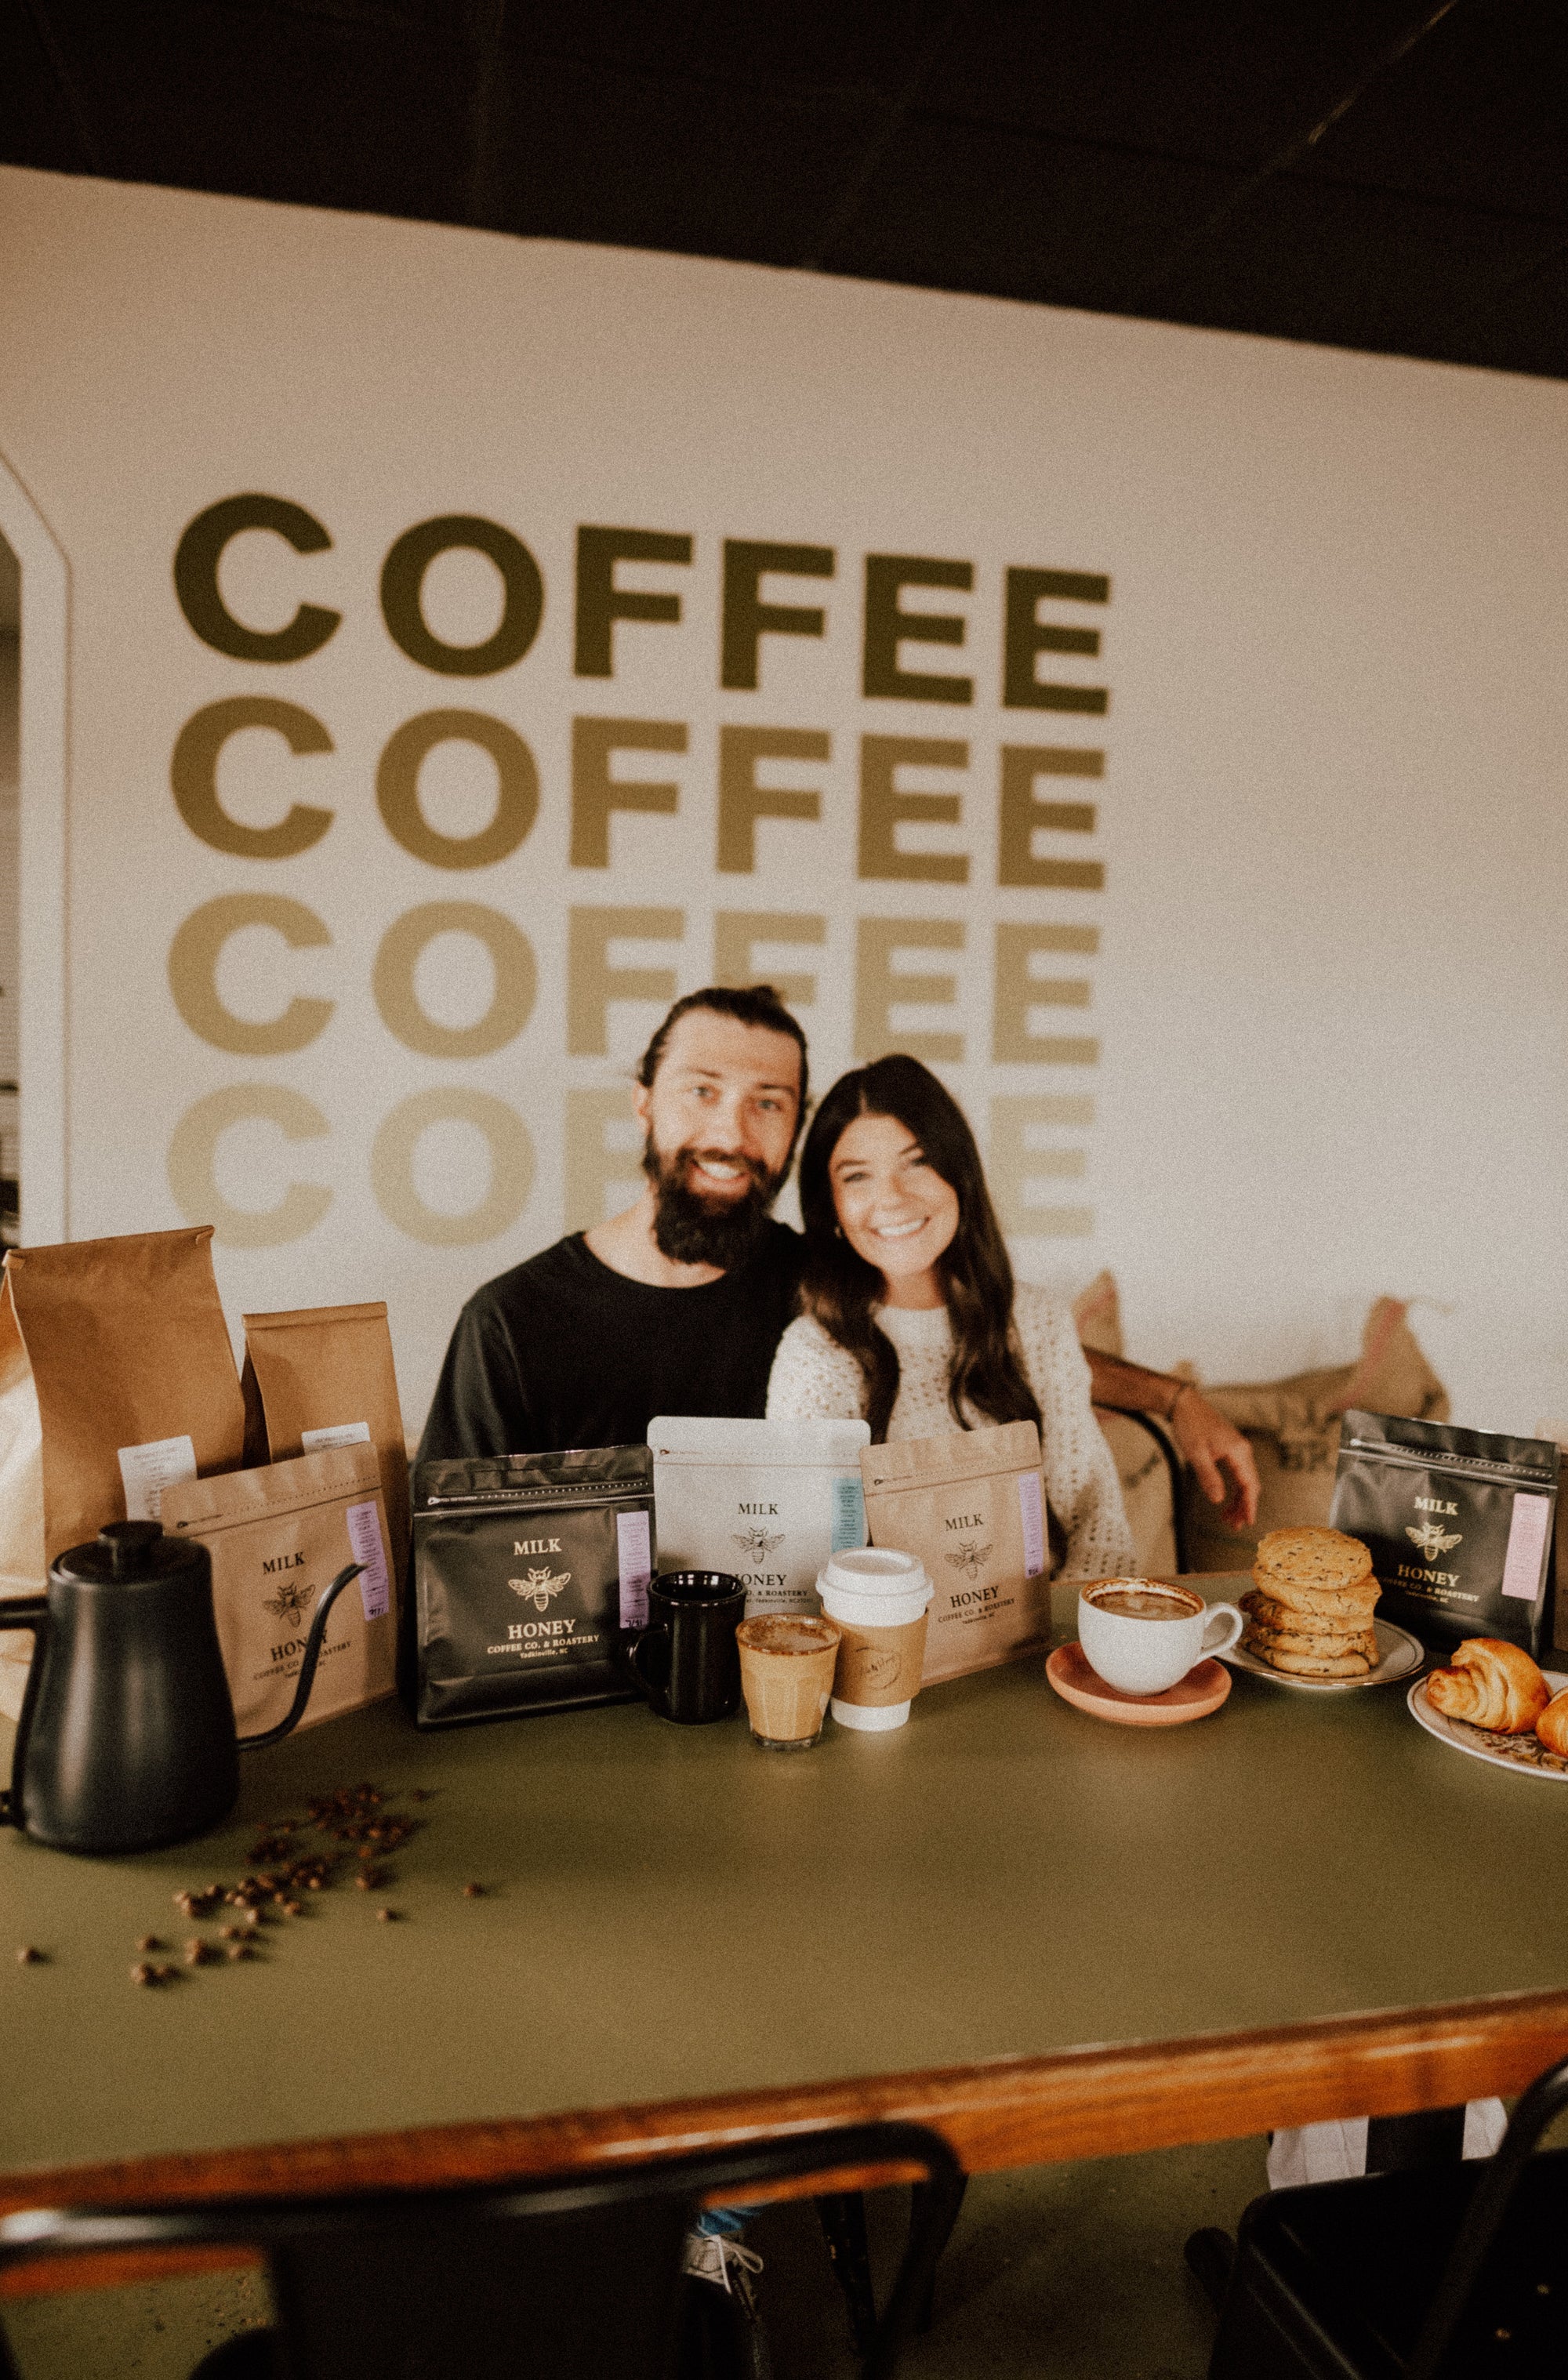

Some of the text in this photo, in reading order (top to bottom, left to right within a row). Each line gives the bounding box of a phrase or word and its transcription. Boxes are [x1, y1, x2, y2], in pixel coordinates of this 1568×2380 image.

[173, 491, 1111, 717] COFFEE
[169, 695, 1106, 892] COFFEE
[165, 891, 1101, 1065] COFFEE
[165, 1082, 1097, 1250] COFE
[737, 1503, 779, 1515] MILK
[1414, 1496, 1459, 1516] MILK
[944, 1513, 985, 1533] MILK
[514, 1537, 563, 1556] MILK
[263, 1551, 306, 1575] MILK
[1396, 1563, 1461, 1587] HONEY
[949, 1585, 1000, 1609] HONEY
[507, 1618, 576, 1640] HONEY
[487, 1643, 522, 1655] COFFEE
[524, 1642, 541, 1650] CO.
[553, 1634, 600, 1647] ROASTERY
